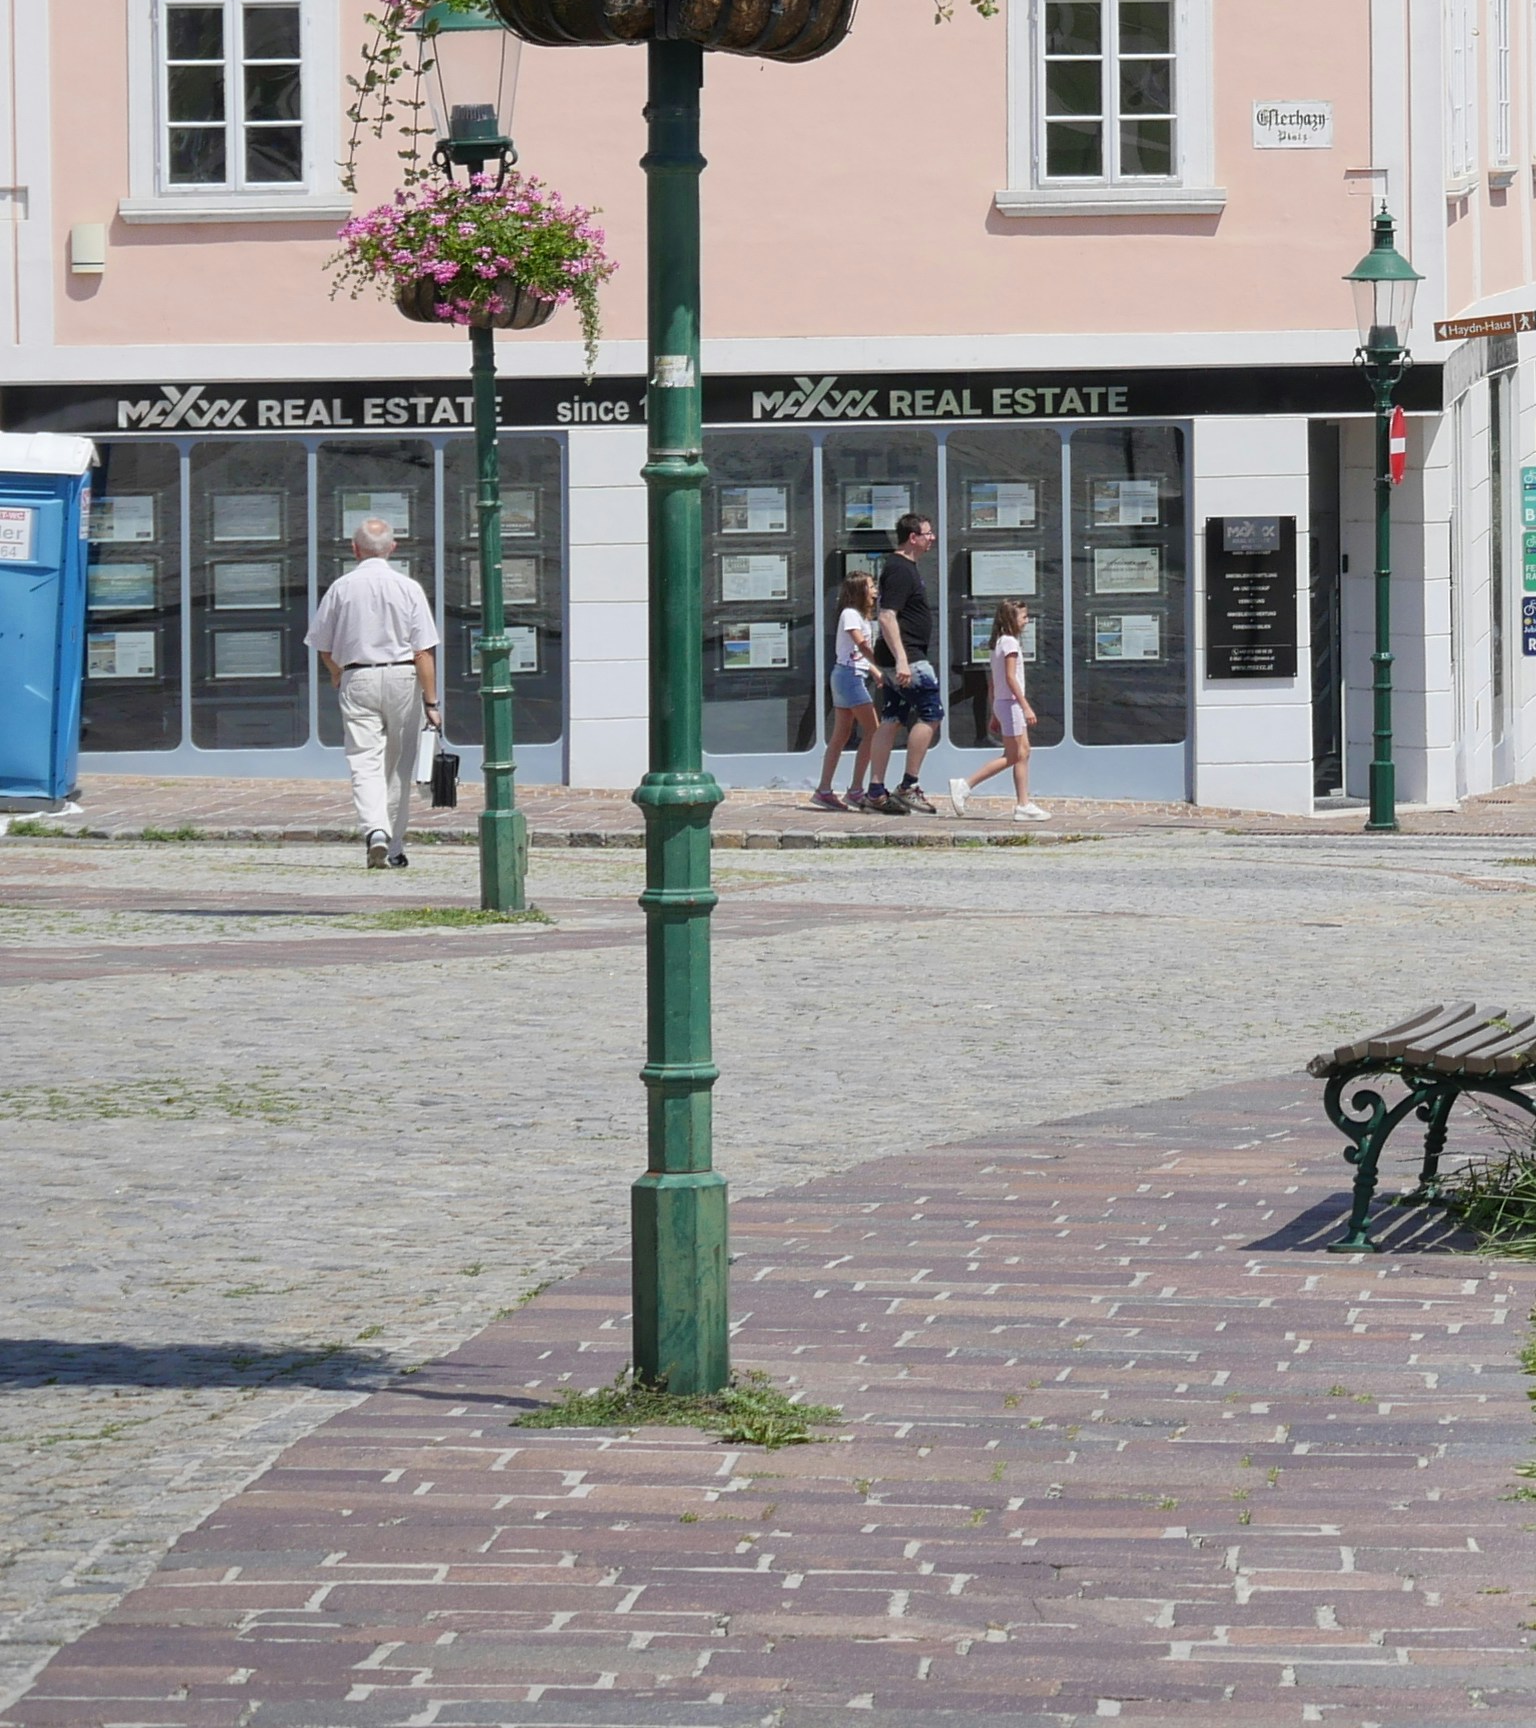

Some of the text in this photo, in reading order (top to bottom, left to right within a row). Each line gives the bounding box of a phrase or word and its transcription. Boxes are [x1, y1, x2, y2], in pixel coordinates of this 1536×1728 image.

[1448, 320, 1511, 336] Haydn-Haus
[257, 399, 353, 426] REAL
[557, 395, 630, 422] since
[890, 389, 982, 416] REAL
[993, 386, 1128, 415] ESTATE
